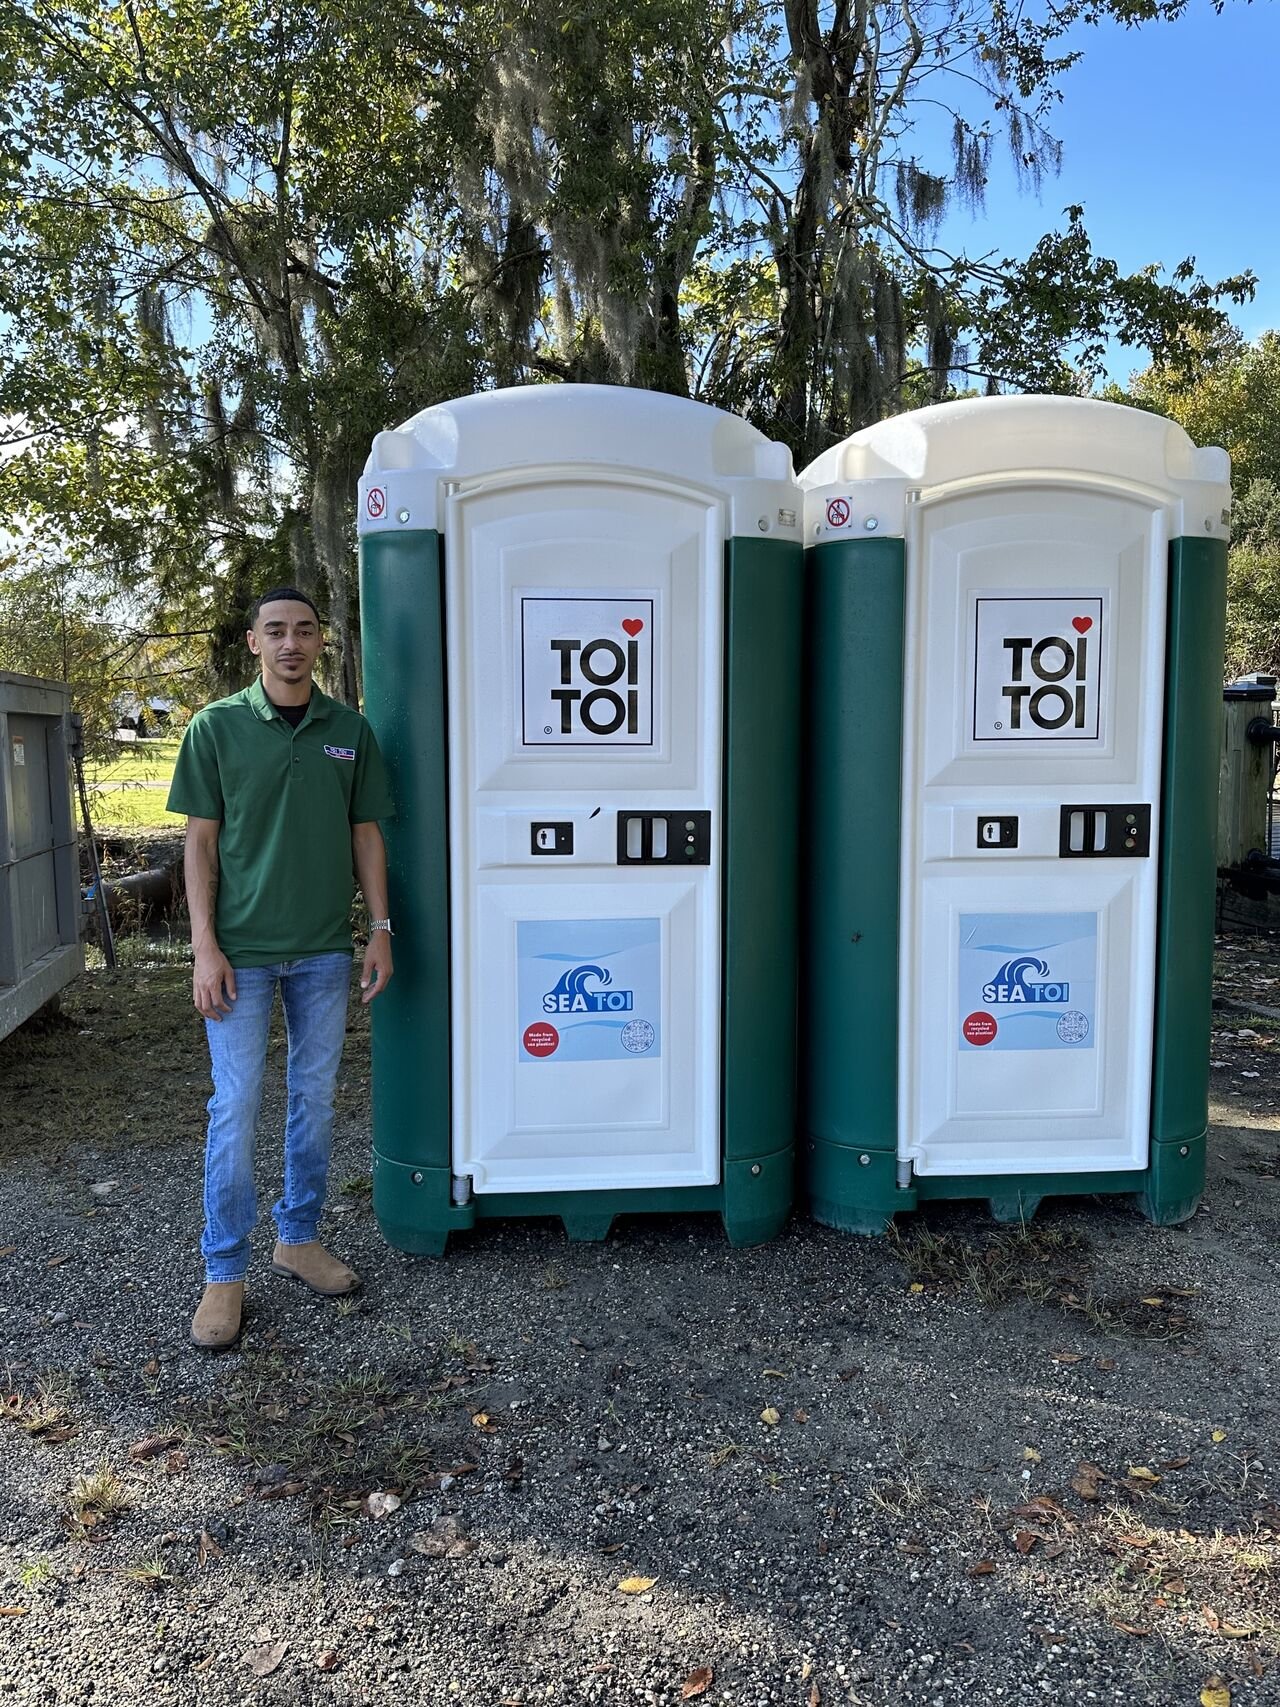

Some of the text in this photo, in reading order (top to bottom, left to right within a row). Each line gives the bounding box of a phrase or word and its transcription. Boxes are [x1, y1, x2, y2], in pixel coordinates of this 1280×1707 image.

[551, 639, 638, 686] TOI
[1003, 637, 1087, 682] TOI
[551, 688, 638, 735] TOI
[1002, 684, 1085, 730] TOI
[543, 991, 632, 1012] SEA TOI
[983, 983, 1068, 1002] SEA TOI
